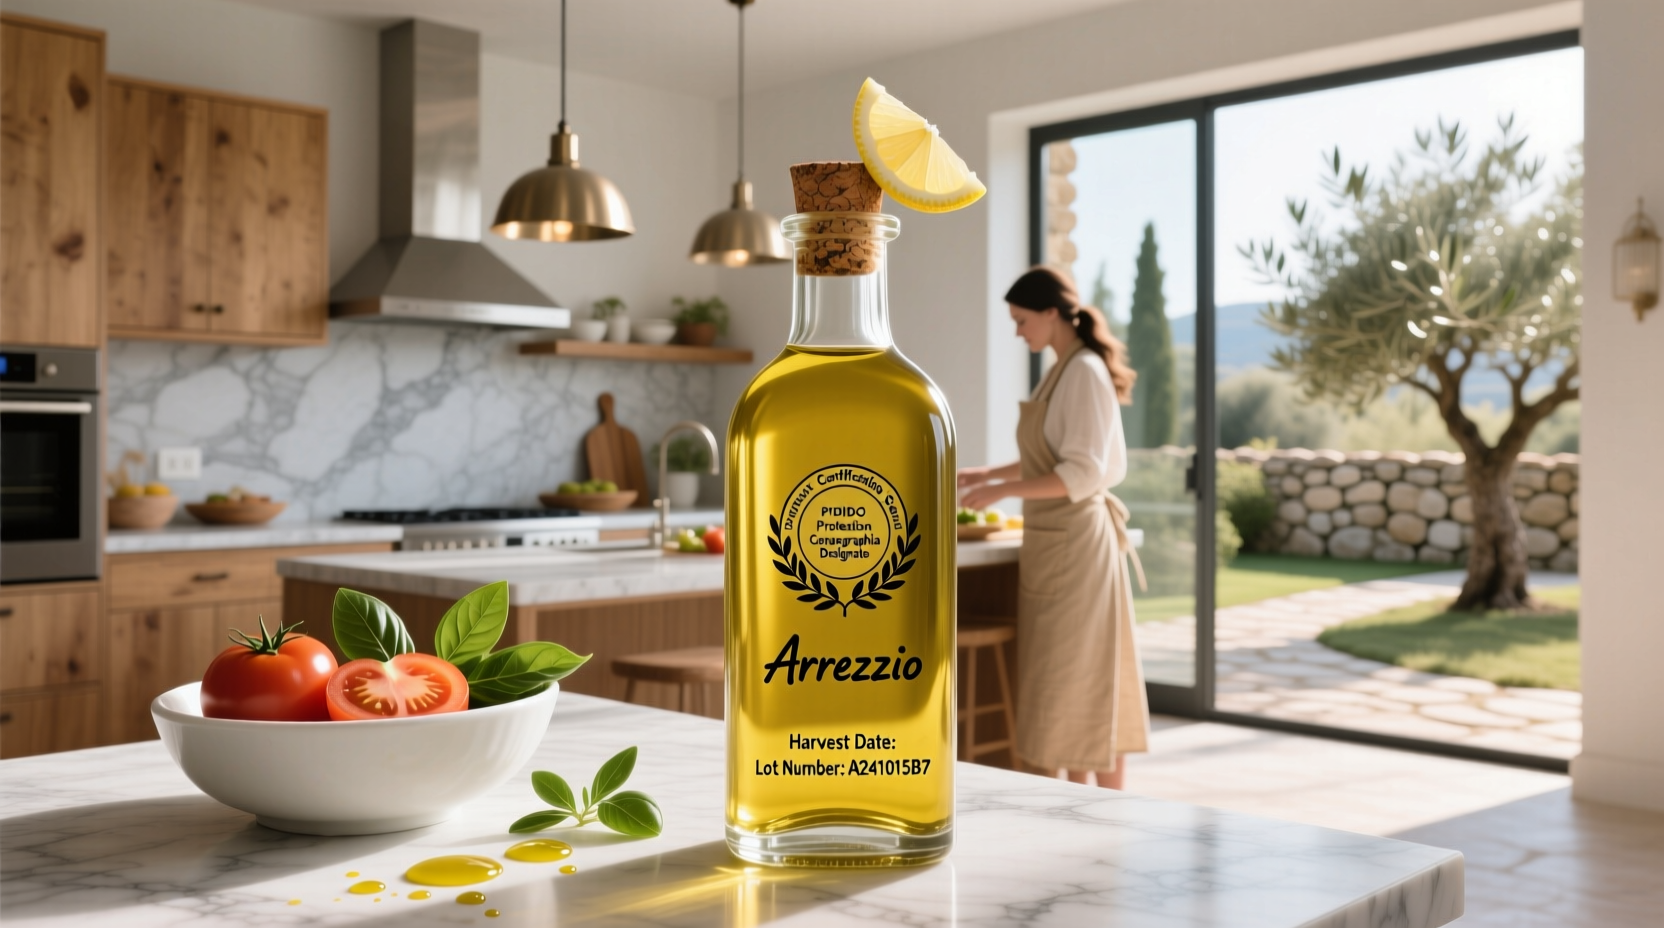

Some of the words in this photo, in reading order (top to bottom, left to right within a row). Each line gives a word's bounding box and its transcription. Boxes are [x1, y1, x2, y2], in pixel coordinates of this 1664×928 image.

[763, 634, 922, 685] Arrezzio
[789, 733, 850, 749] Harvest
[854, 734, 896, 749] Date:
[755, 759, 779, 775] Lot
[782, 759, 845, 776] Number:
[848, 759, 931, 775] A241015B7
